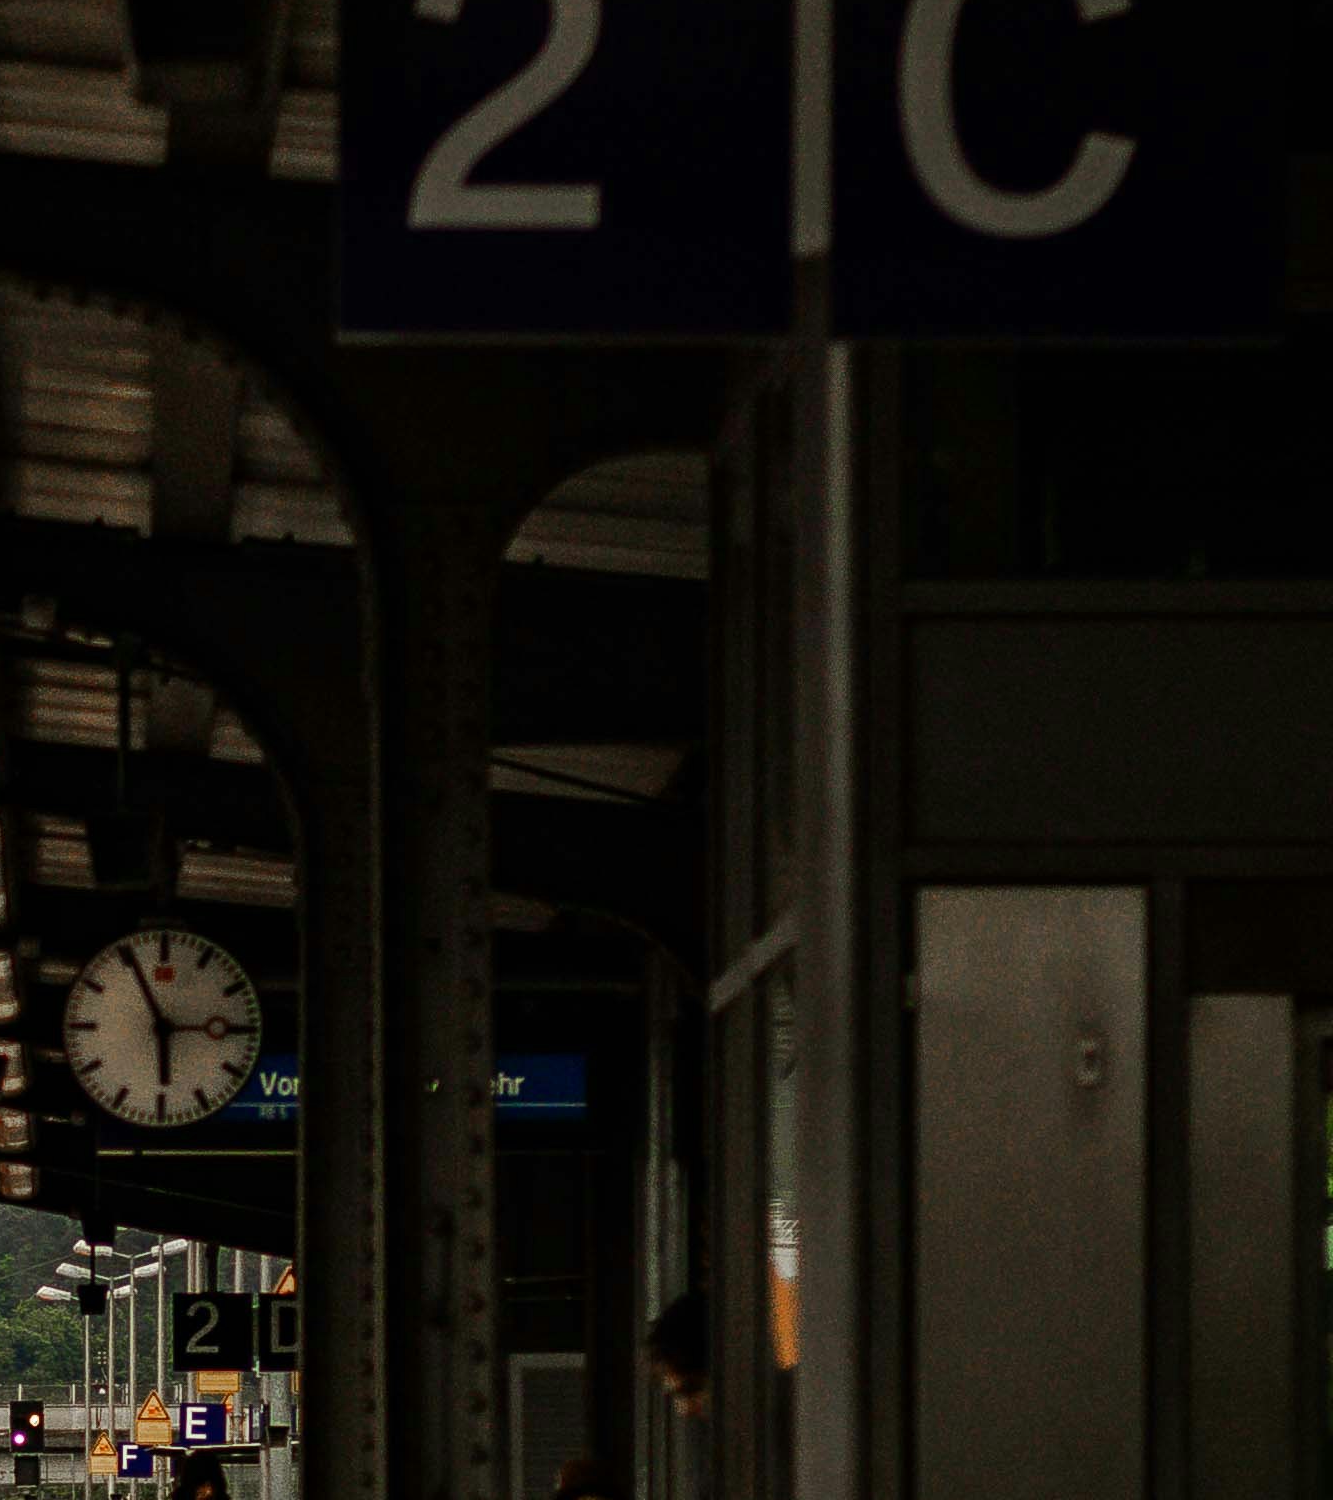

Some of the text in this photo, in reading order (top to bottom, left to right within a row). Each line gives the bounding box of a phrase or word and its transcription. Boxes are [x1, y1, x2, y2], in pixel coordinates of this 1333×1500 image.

[185, 1299, 221, 1354] 2
[185, 1406, 208, 1440] E
[121, 1444, 139, 1471] F
